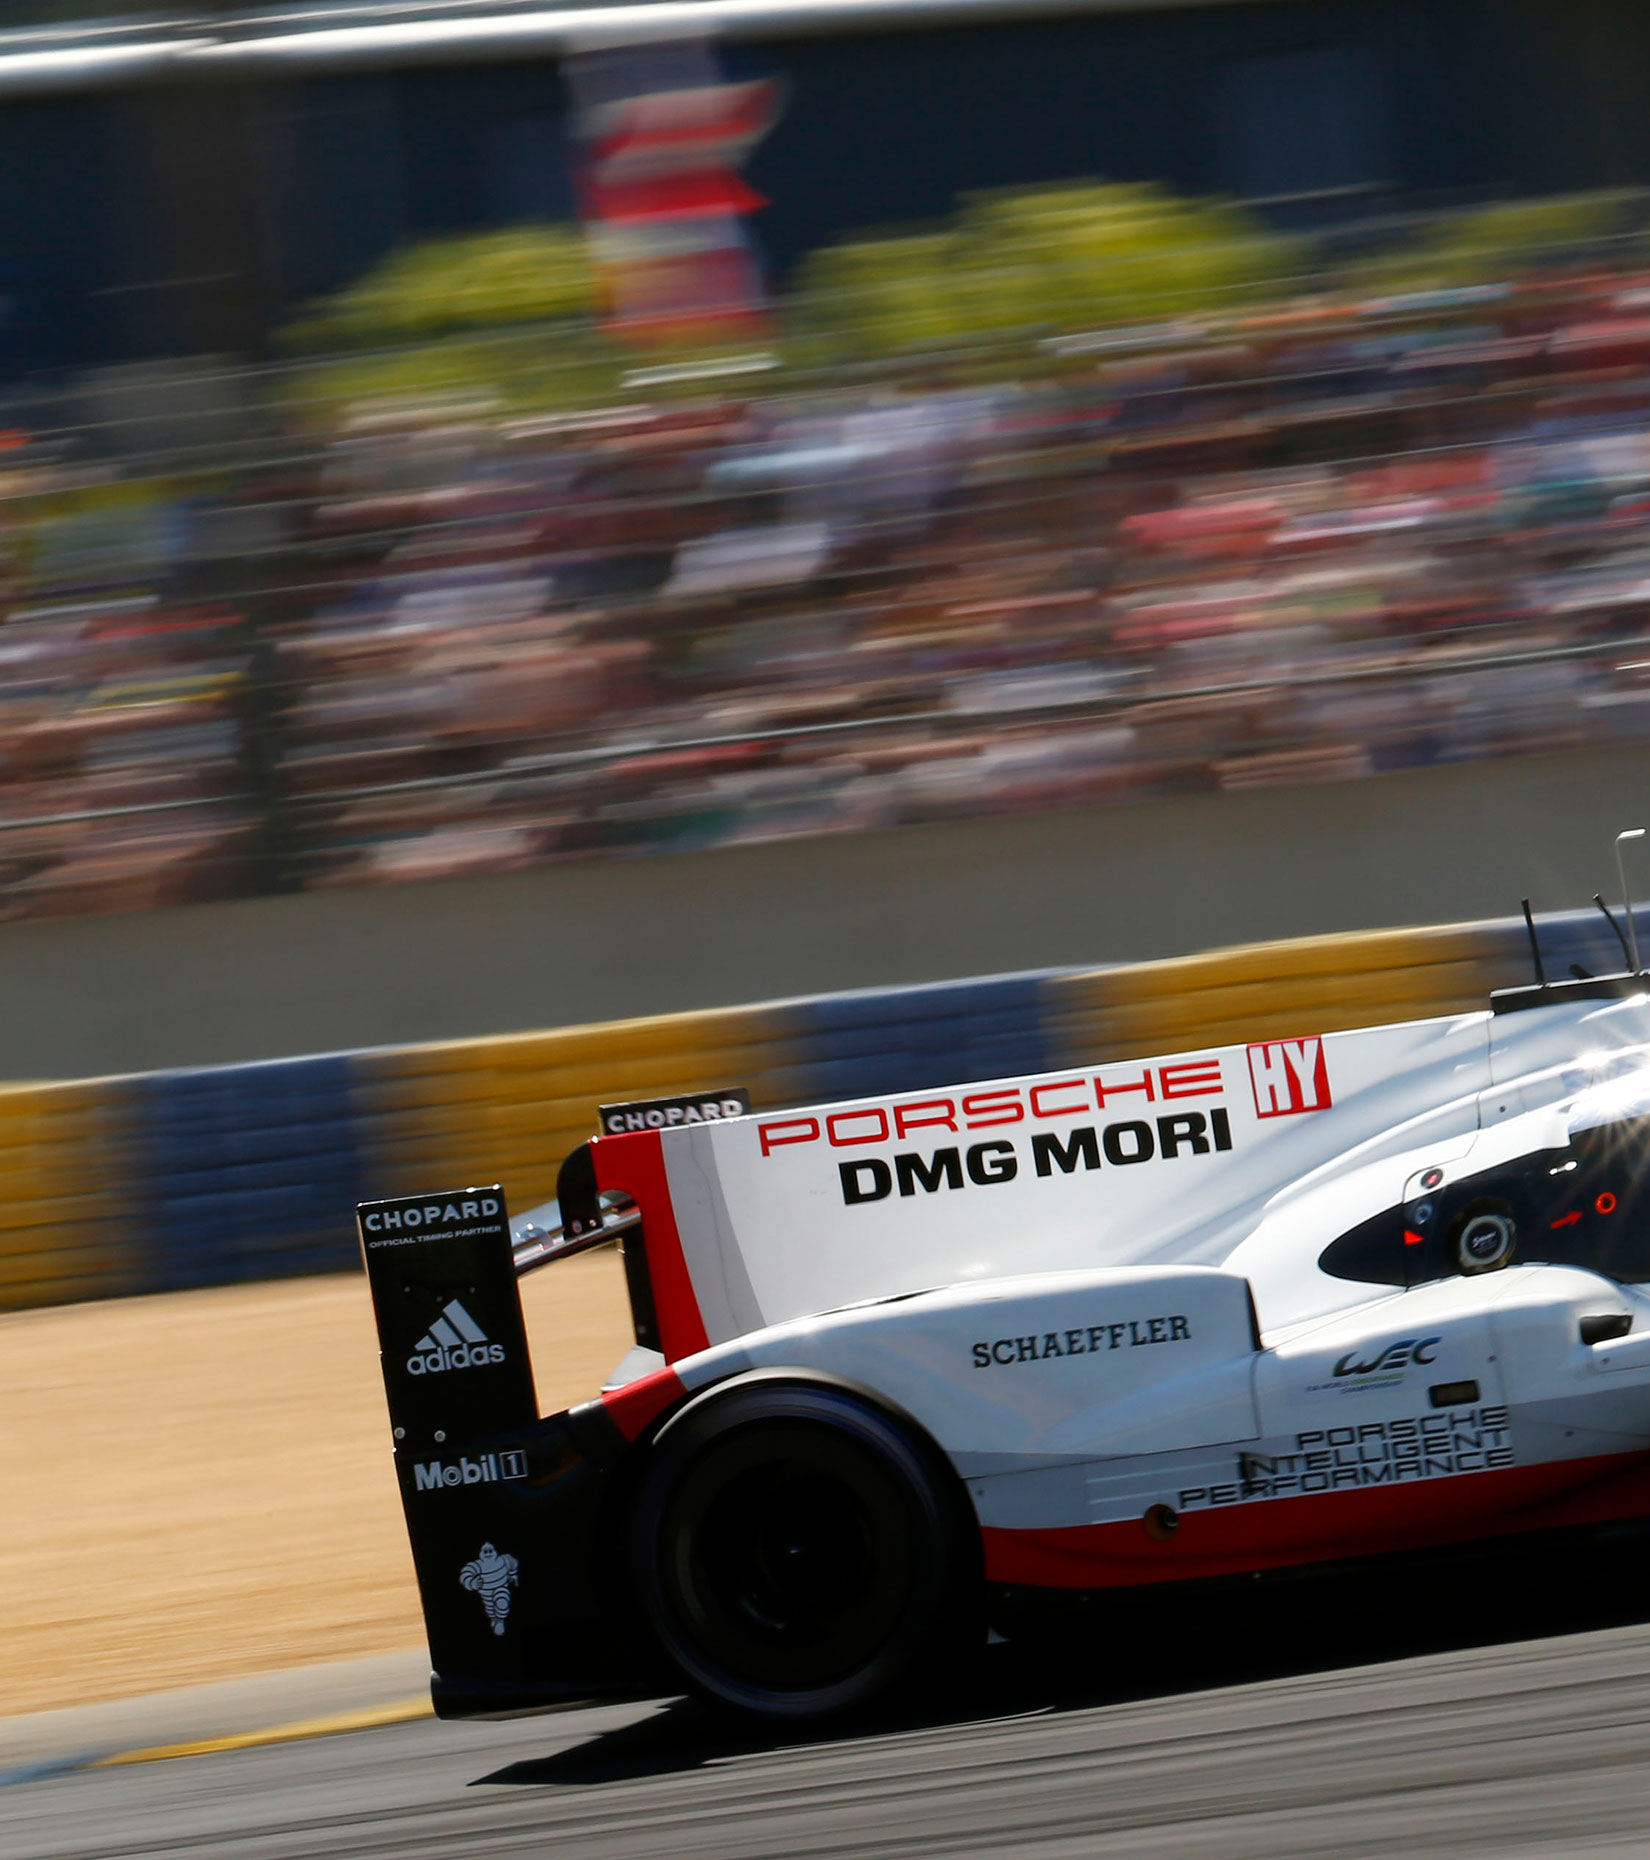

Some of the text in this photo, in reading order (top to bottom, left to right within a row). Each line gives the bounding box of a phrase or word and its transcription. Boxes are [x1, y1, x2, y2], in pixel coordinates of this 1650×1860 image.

[1247, 1036, 1332, 1118] HY
[606, 1099, 744, 1133] CHOPARD
[758, 1060, 1224, 1157] PORSCHE
[838, 1107, 1233, 1205] DMG MORI
[364, 1199, 499, 1232] CHOPARD
[369, 1224, 502, 1249] OFFICIAL TIMING PARTNER
[406, 1343, 506, 1376] adidas
[971, 1314, 1192, 1369] SCHAEFFLER
[1332, 1336, 1443, 1377] WEC
[1297, 1405, 1508, 1452] PORSCHE
[413, 1453, 499, 1491] Mobil
[1178, 1446, 1515, 1509] PERFORMANCE
